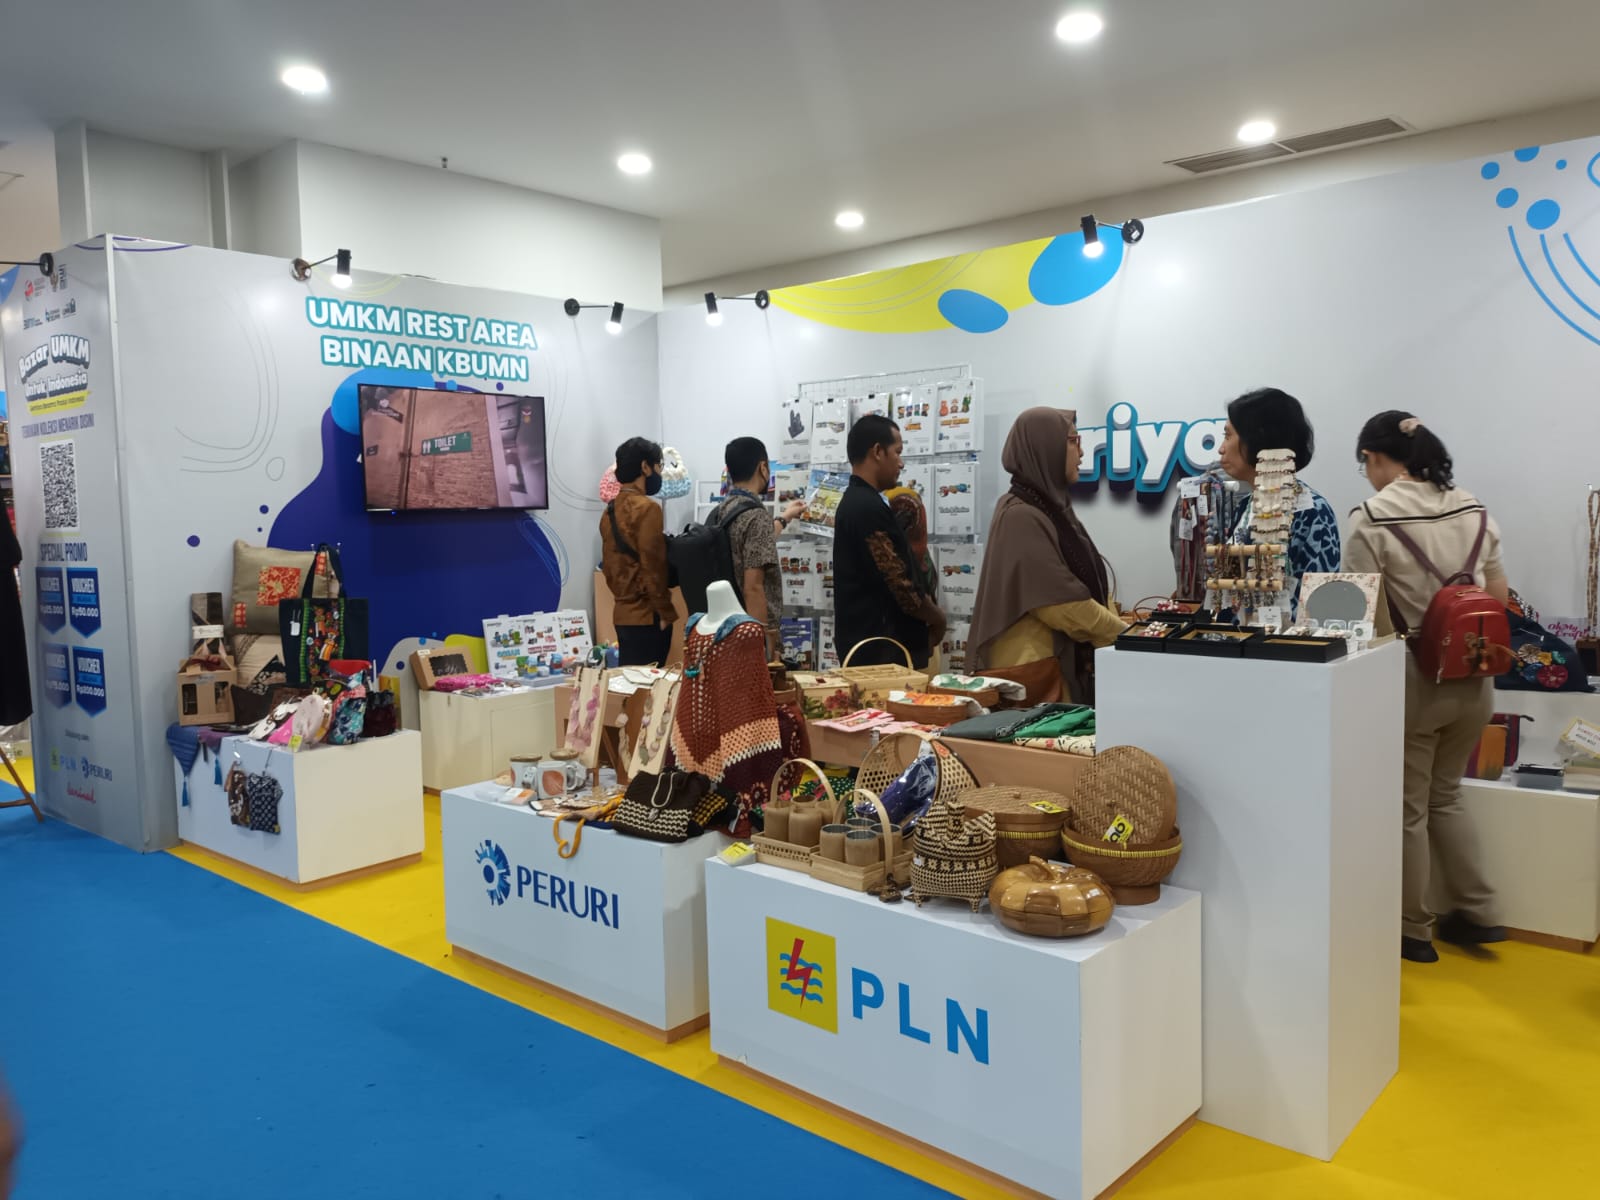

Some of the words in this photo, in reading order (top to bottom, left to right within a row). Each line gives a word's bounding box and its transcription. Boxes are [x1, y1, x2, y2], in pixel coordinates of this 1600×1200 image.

[306, 296, 402, 334] UMKM
[405, 309, 469, 343] REST
[471, 320, 538, 350] AREA
[18, 344, 49, 382] Bazar
[50, 334, 91, 369] UMKM
[321, 336, 434, 371] BINAAN
[434, 347, 529, 381] KBUMN
[47, 371, 88, 397] Indonesia
[434, 435, 456, 448] TOILET
[65, 542, 88, 561] PROMO
[516, 864, 620, 930] PERURI
[851, 967, 990, 1065] PLN
